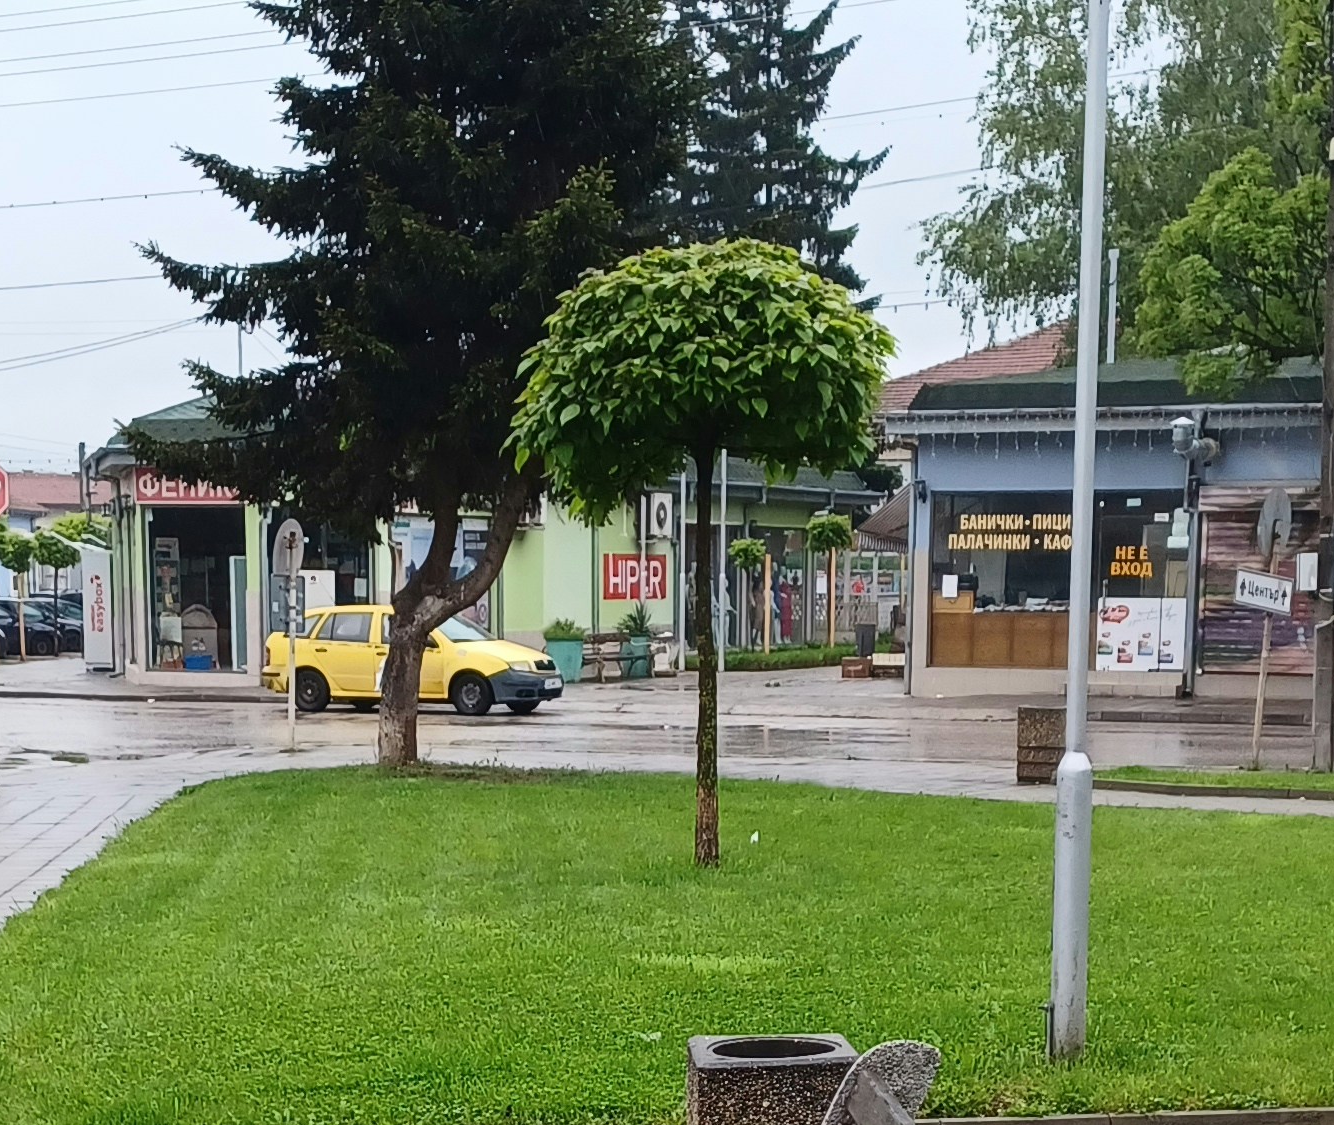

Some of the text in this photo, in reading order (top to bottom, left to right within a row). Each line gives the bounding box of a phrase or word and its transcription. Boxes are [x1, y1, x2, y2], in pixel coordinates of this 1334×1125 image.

[960, 513, 1071, 530] БАНИЧКИ ПИЦИ
[948, 534, 1072, 550] ПАЛАЧИНКИ КАФ
[1116, 546, 1148, 560] НЕ Е
[1111, 562, 1153, 578] ВХОД
[1248, 580, 1279, 604] Център
[94, 582, 105, 632] easybox
